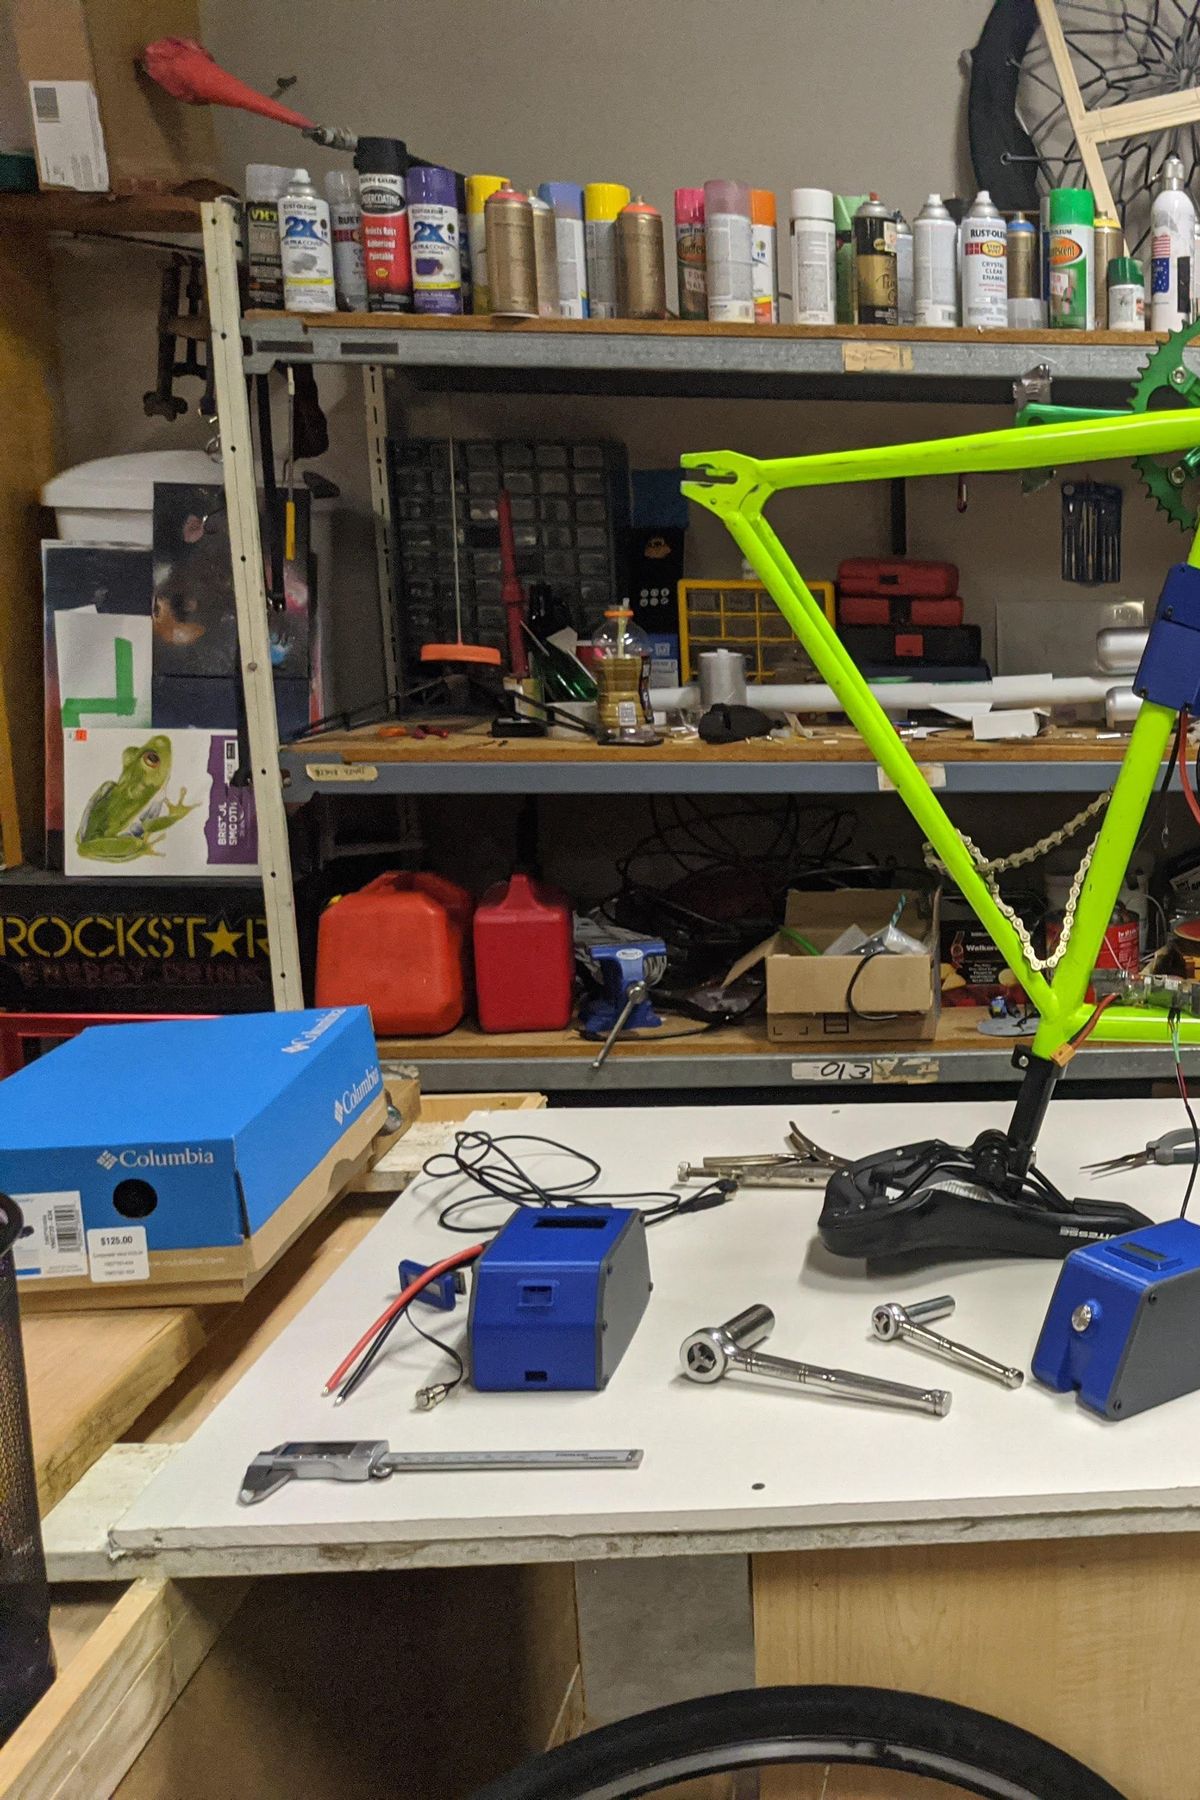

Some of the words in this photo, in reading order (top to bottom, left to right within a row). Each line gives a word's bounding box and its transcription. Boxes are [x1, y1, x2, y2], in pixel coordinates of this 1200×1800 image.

[284, 216, 318, 240] 2X
[413, 221, 444, 243] 2X
[342, 1065, 380, 1114] Columbia
[119, 1147, 214, 1168] Columbia
[100, 1235, 133, 1246] $125.00
